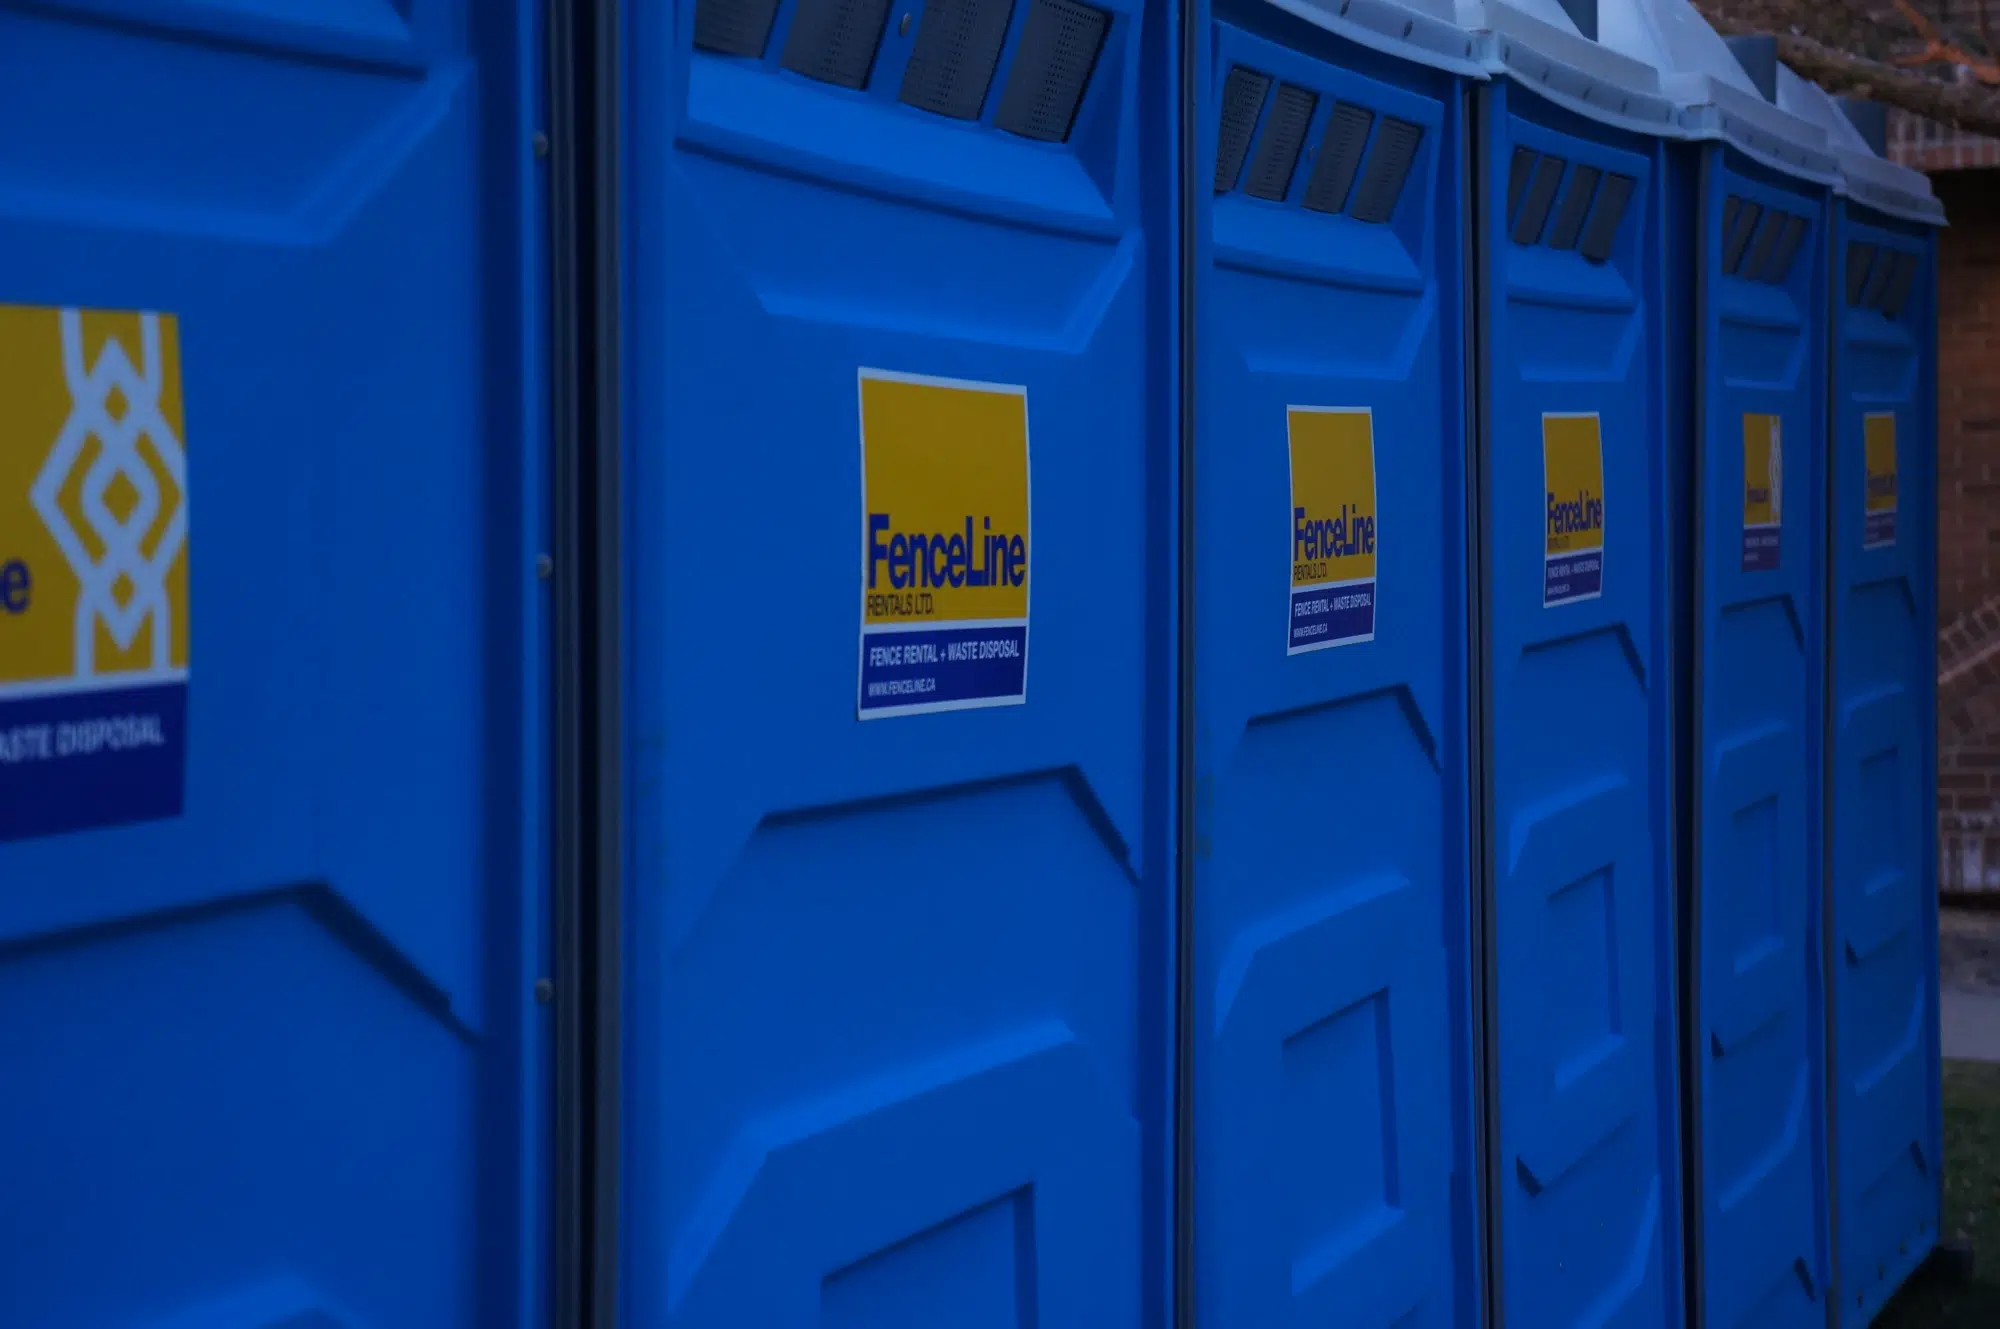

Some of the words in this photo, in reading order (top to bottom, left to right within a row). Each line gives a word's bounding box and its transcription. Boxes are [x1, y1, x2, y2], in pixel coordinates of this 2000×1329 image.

[1294, 503, 1374, 561] FenceLine
[1547, 489, 1601, 534] FenceLine
[868, 513, 1026, 589] FenceLine
[867, 594, 912, 617] RENTALS
[869, 645, 902, 667] FENCE
[903, 644, 938, 665] RENTAL
[947, 641, 978, 662] WASTE
[979, 639, 1020, 660] DISPOSAL
